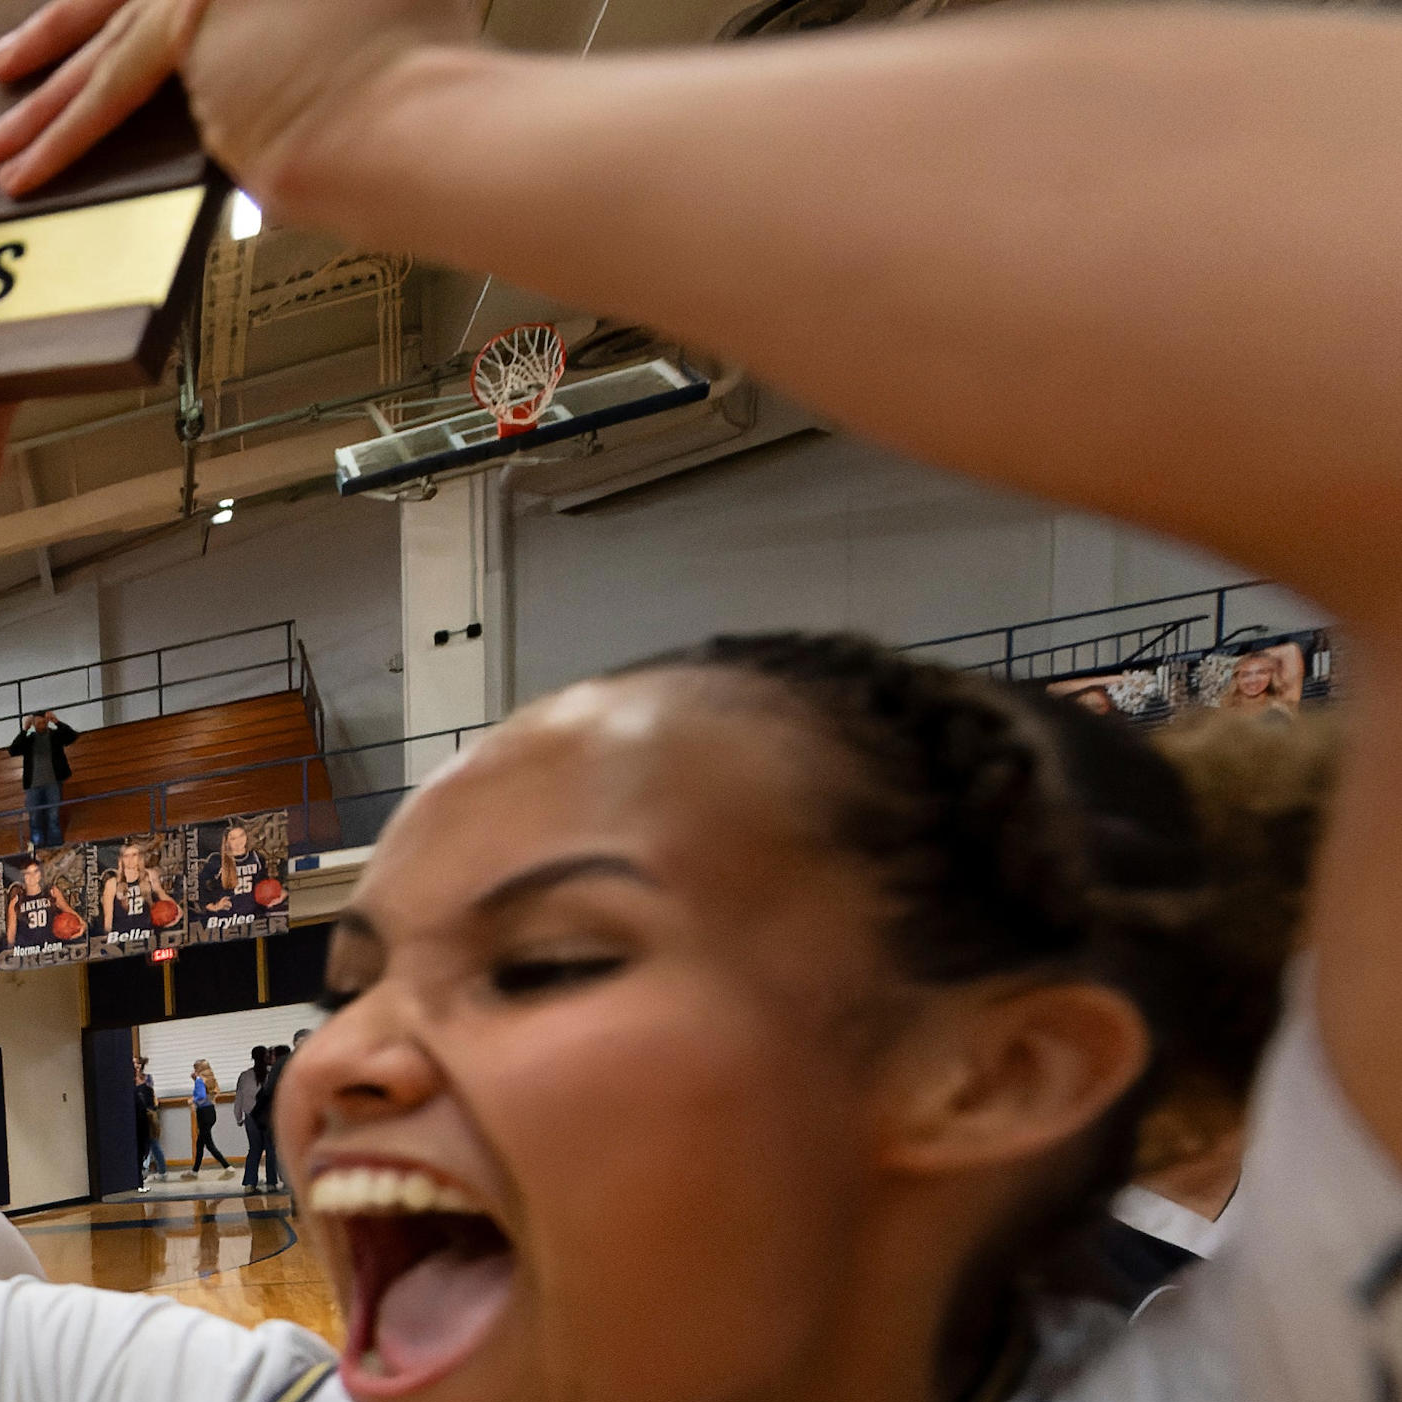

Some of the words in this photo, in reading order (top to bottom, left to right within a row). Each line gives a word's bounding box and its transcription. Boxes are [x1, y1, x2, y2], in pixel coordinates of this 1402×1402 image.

[127, 897, 144, 916] 12
[28, 910, 47, 929] 30
[207, 913, 256, 929] Brylee
[107, 928, 151, 945] Bella
[13, 945, 41, 957] Norma
[41, 941, 63, 953] Jean
